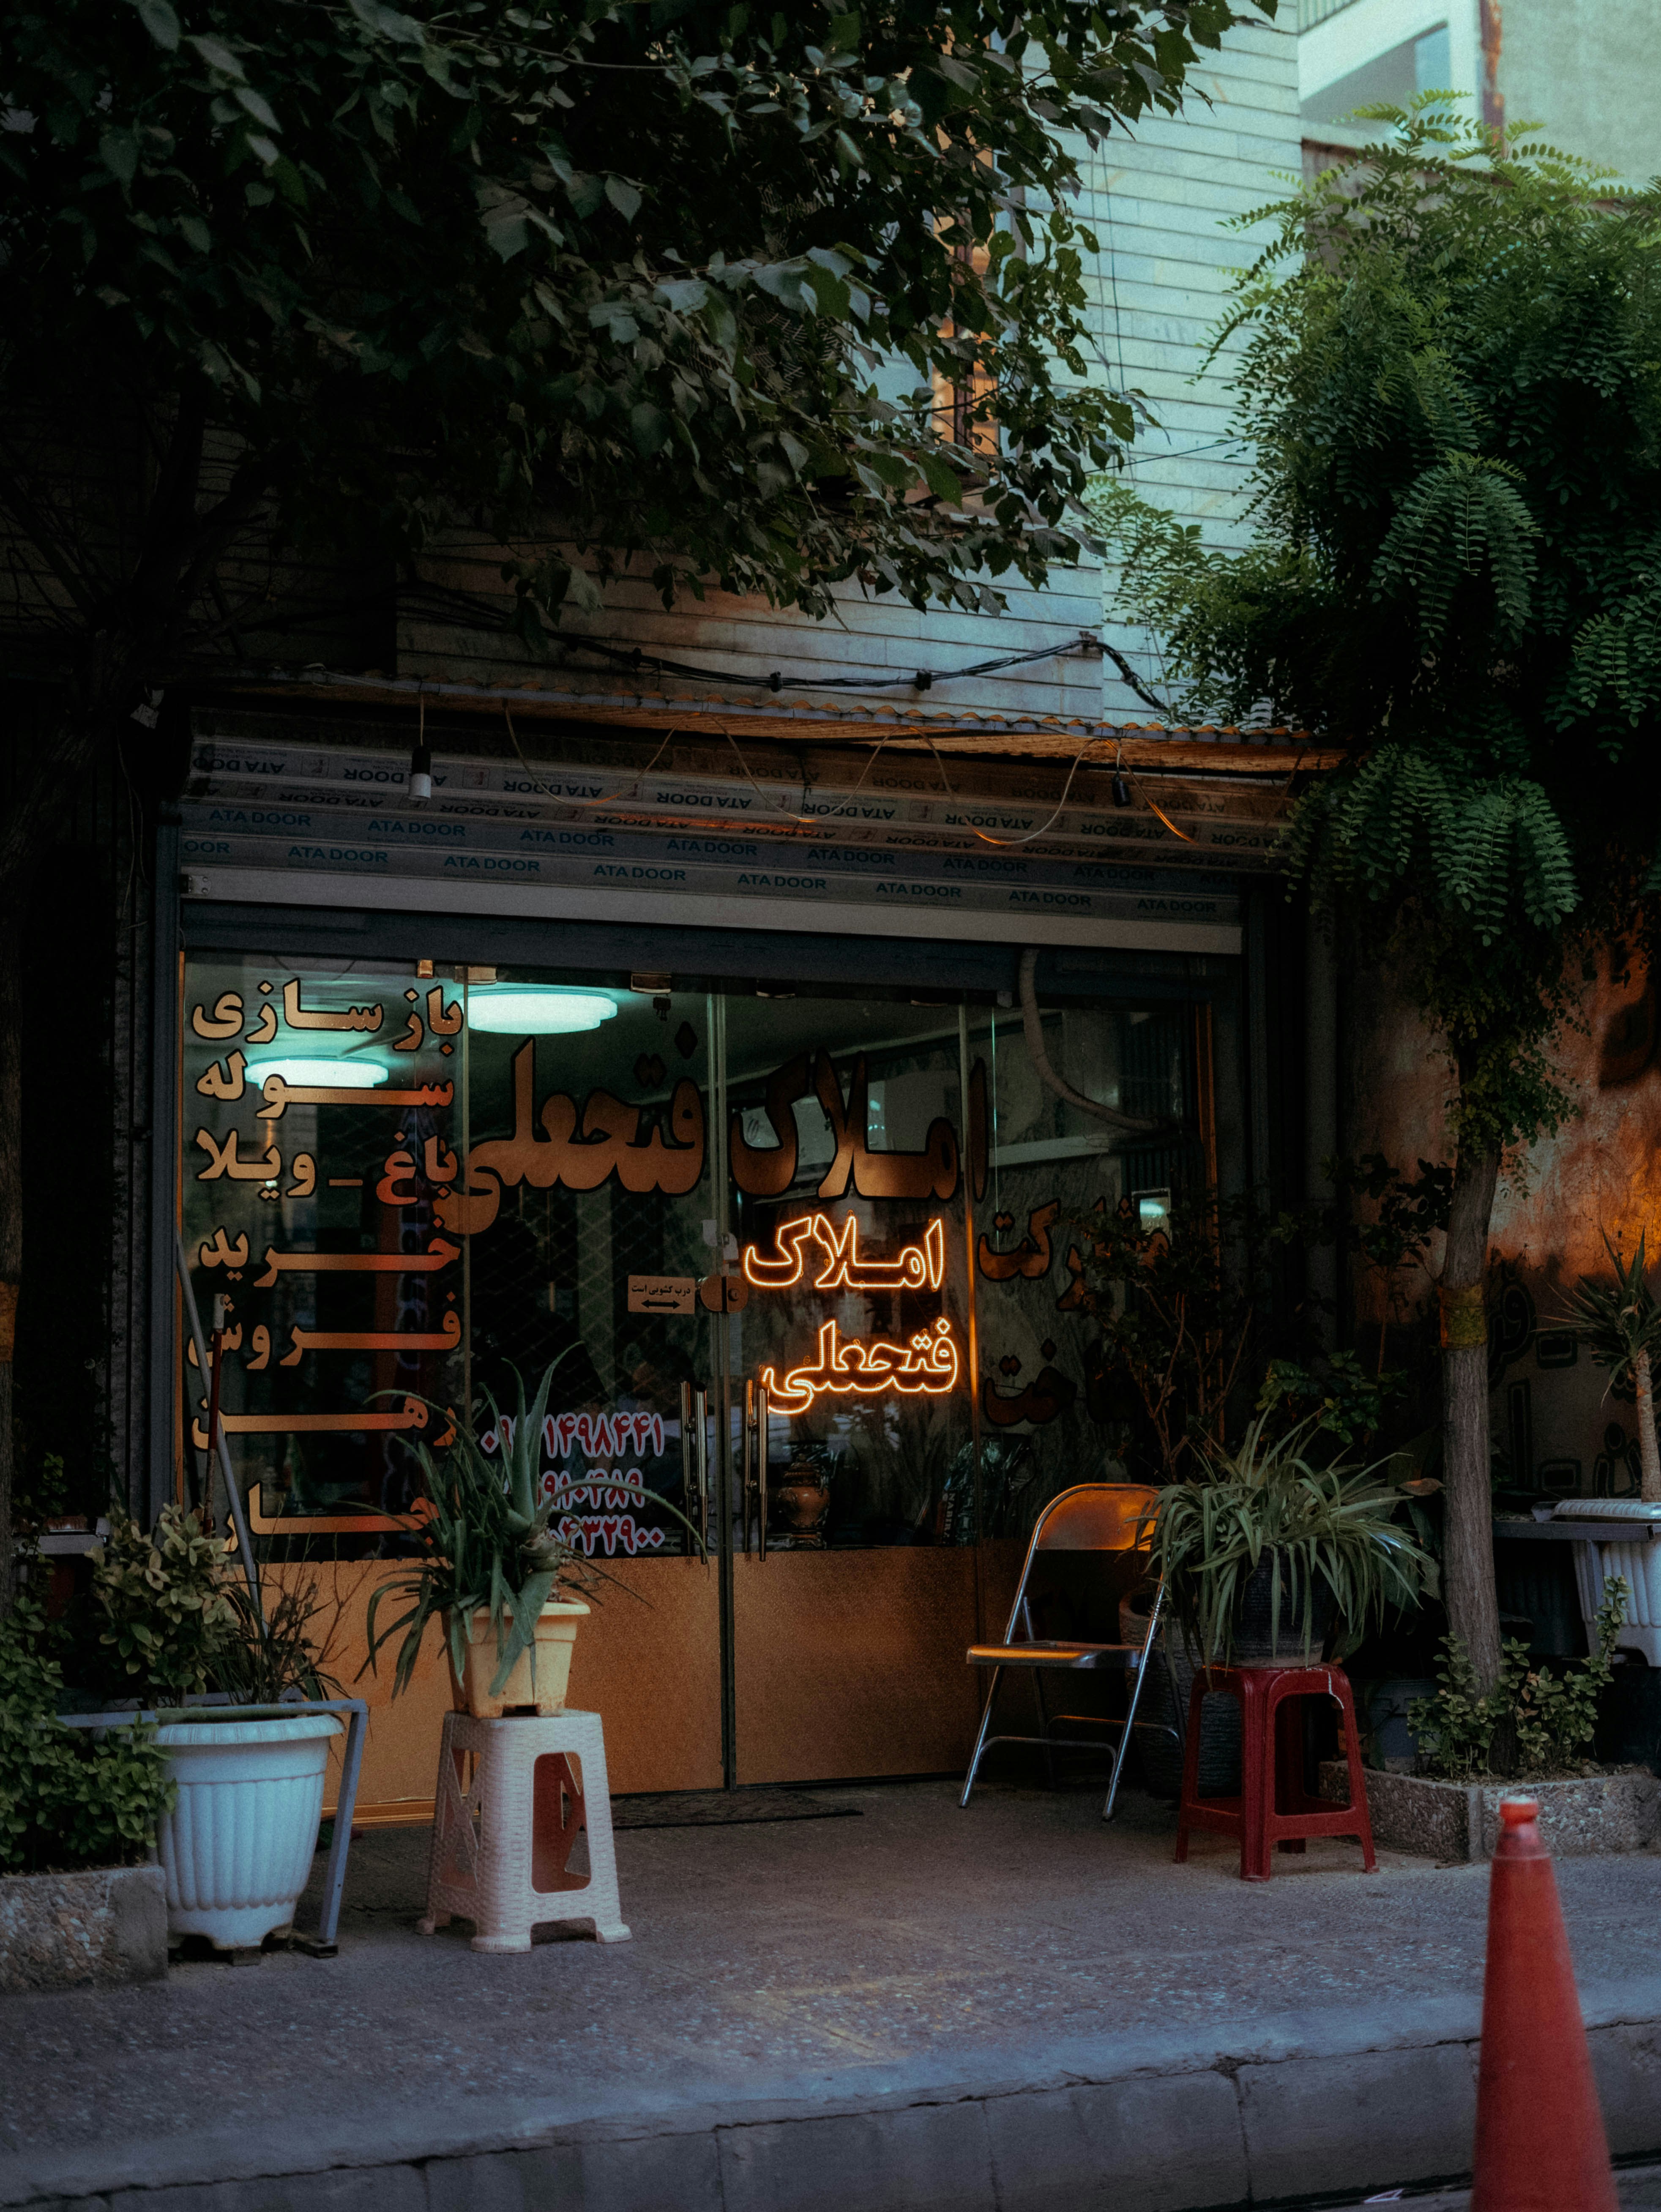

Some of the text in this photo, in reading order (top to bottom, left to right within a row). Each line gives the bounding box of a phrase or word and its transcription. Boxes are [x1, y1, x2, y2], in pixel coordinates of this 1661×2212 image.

[193, 758, 285, 773] ATA DOO
[344, 768, 404, 783] DOOR
[503, 781, 603, 797] ATA DOOR
[279, 793, 383, 808] ATA DOOR
[656, 792, 752, 808] ATA DOOR
[210, 810, 311, 827] ATA DOOR
[440, 805, 541, 818] ATA DOOR
[804, 803, 896, 819] ATA DOOR
[368, 820, 466, 836] ATA DOOR
[594, 816, 651, 826] DOOR
[1000, 818, 1033, 829] ATA
[520, 830, 615, 846] ATA DOOR
[885, 836, 939, 847] DOOR
[183, 841, 230, 853] OOR
[288, 847, 388, 863] ATA DOOR
[667, 839, 757, 856] ATA DOOR
[444, 856, 541, 873] ATA DOOR
[808, 849, 895, 864] ATA DOOR
[594, 865, 686, 881] ATA DOOR
[943, 858, 1028, 873] ATA DOOR
[738, 874, 826, 889] ATA DOOR
[877, 882, 961, 897] ATA DOOR
[1009, 891, 1091, 906] ATA DOOR
[1138, 899, 1216, 912] ATA DOOR
[191, 977, 464, 1057] باز سازی
[195, 1048, 455, 1120] سوله
[431, 1021, 988, 1236] املاک فتحعلی
[194, 1127, 318, 1201] ویلا
[375, 1130, 459, 1206] باغ
[198, 1215, 462, 1288] خرید
[743, 1213, 945, 1291] املاک
[631, 1284, 647, 1292] است
[675, 1287, 691, 1297] درب
[187, 1291, 462, 1370] فروش
[761, 1316, 959, 1416] فتحعلی
